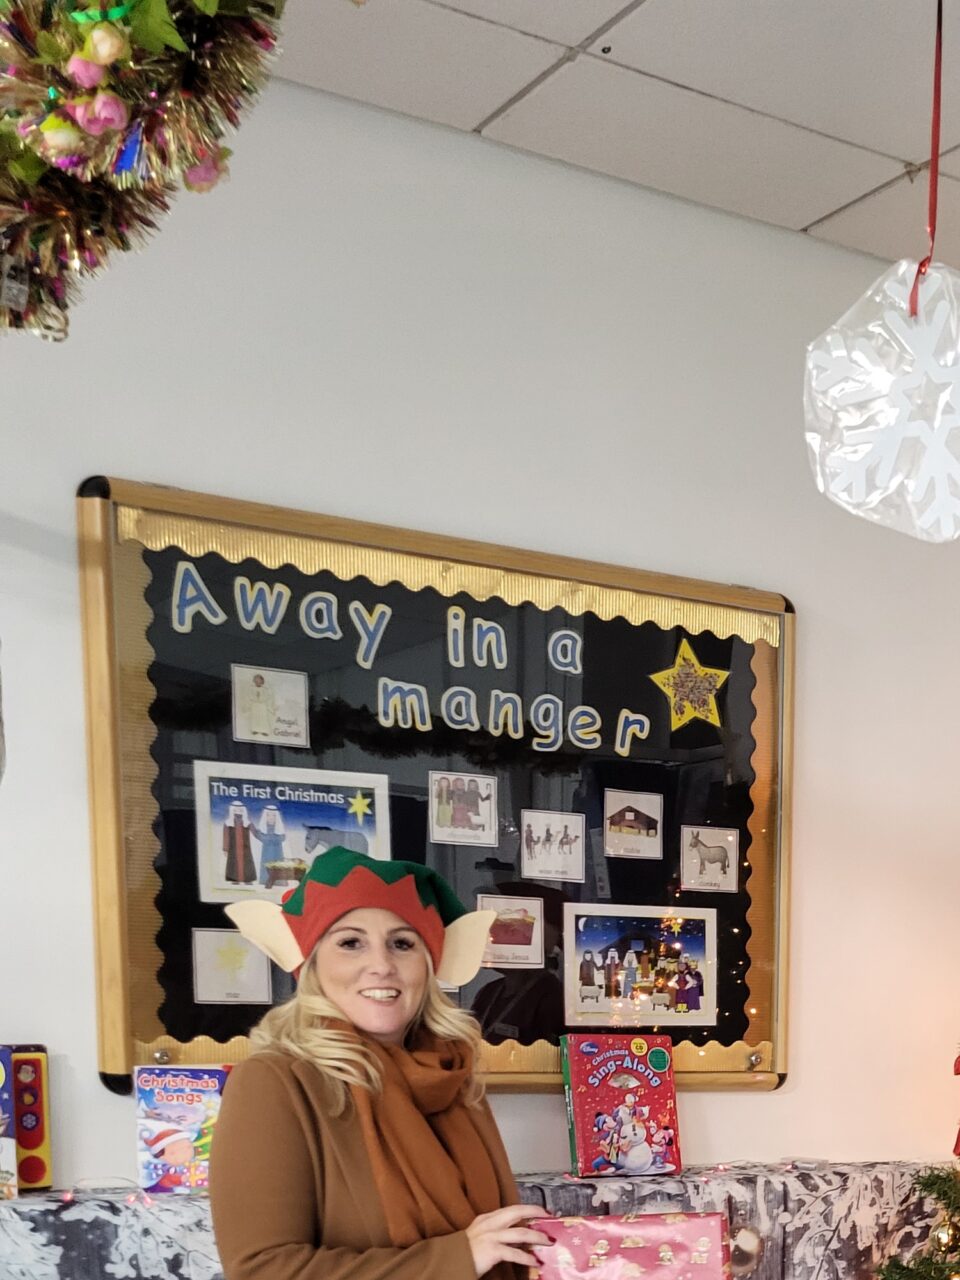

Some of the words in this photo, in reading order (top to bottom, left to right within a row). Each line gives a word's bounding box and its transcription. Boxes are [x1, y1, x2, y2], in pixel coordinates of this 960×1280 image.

[172, 561, 392, 670] Away
[447, 606, 508, 670] in
[548, 629, 583, 675] a
[378, 677, 650, 757] manger
[211, 782, 239, 797] The
[243, 784, 272, 800] First
[275, 786, 345, 805] Christmas
[592, 1049, 629, 1066] Christmas
[138, 1073, 219, 1091] Christmas
[588, 1056, 661, 1087] Sing-Along
[154, 1089, 204, 1106] Songs
